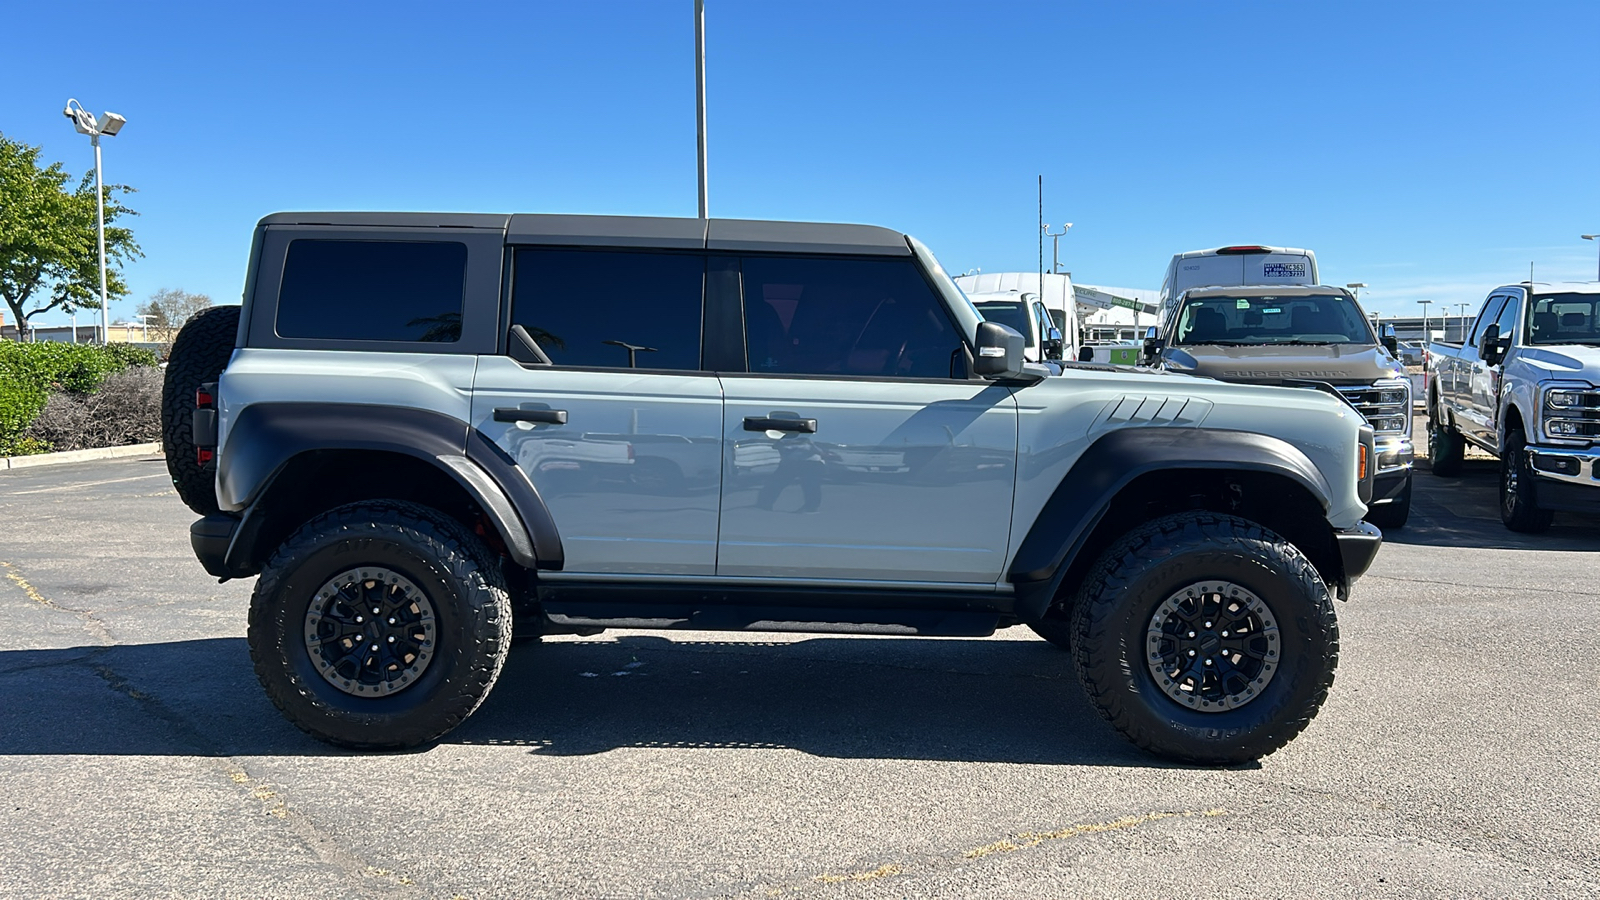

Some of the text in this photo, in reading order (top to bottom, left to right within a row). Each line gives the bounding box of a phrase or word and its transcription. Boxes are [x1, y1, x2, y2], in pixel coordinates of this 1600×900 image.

[1075, 287, 1097, 298] ECURE
[1223, 370, 1350, 379] SUPER DUTY
